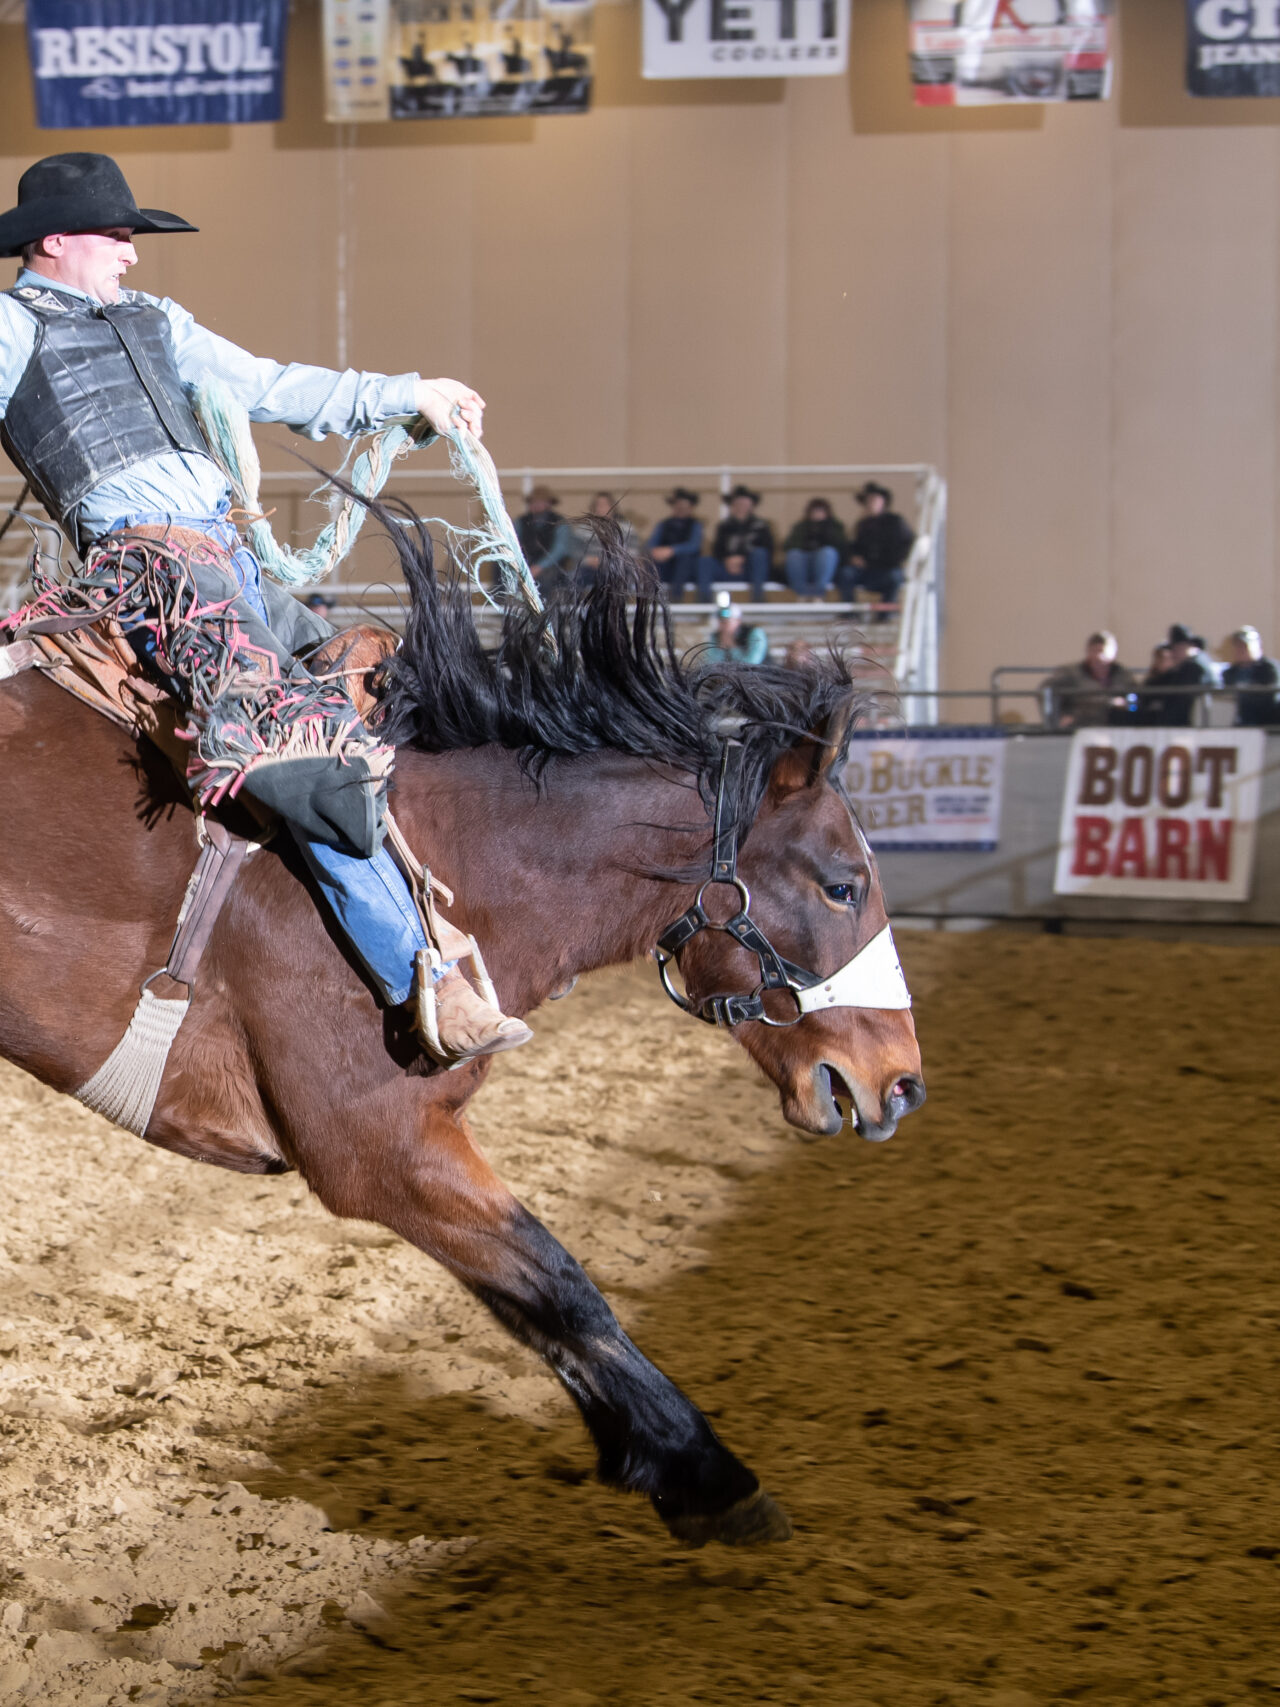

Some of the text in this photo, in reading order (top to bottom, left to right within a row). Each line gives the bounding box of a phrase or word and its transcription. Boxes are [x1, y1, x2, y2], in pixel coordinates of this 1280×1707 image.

[36, 23, 273, 78] RESISTOL
[712, 46, 838, 62] COOLERS
[869, 751, 993, 794] BUCKLE
[1078, 745, 1238, 809] BOOT
[1071, 816, 1234, 882] BARN
